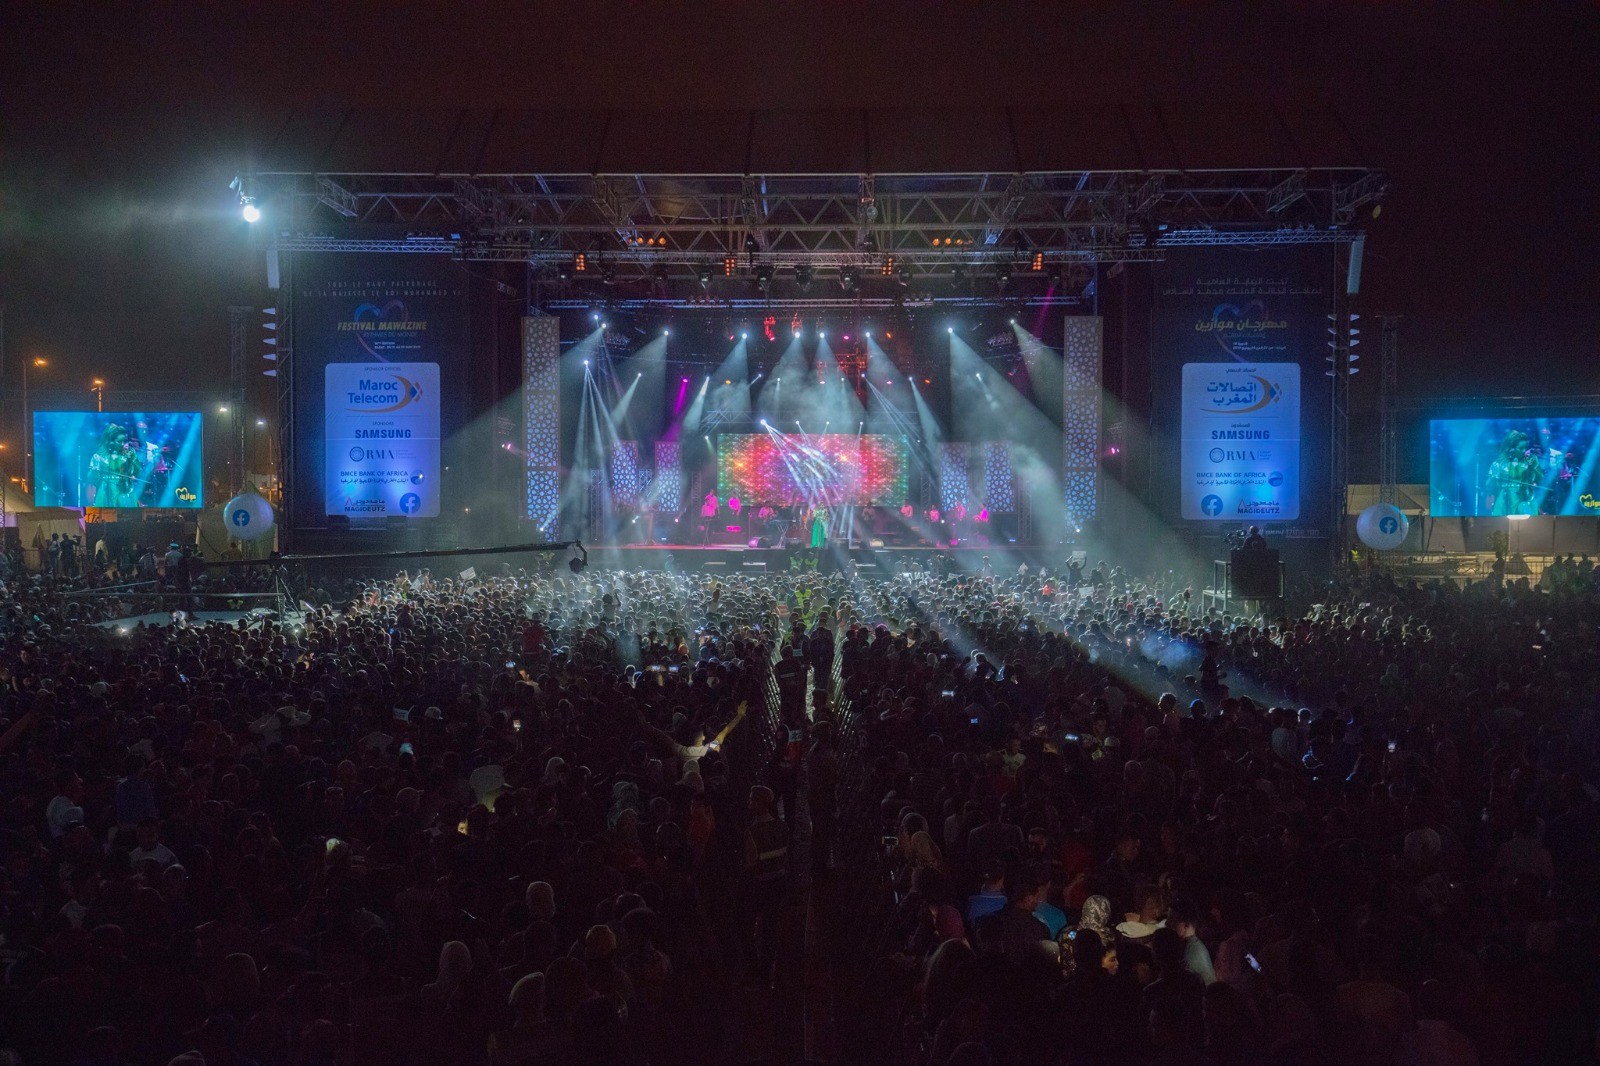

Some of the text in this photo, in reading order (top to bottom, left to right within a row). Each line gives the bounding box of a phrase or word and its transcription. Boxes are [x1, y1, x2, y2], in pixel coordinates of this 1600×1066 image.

[337, 321, 427, 331] FESTIVAL MAWAZINE
[1195, 318, 1288, 332] مهرجان موازين
[359, 379, 398, 391] Maroc
[1207, 382, 1257, 392] اتصالات
[347, 392, 398, 403] Telecom
[1213, 393, 1257, 406] المغرب
[355, 429, 411, 439] SAMSUNG
[1211, 430, 1270, 440] SAMSUNG
[366, 449, 394, 459] RMA
[1227, 450, 1256, 461] RMA
